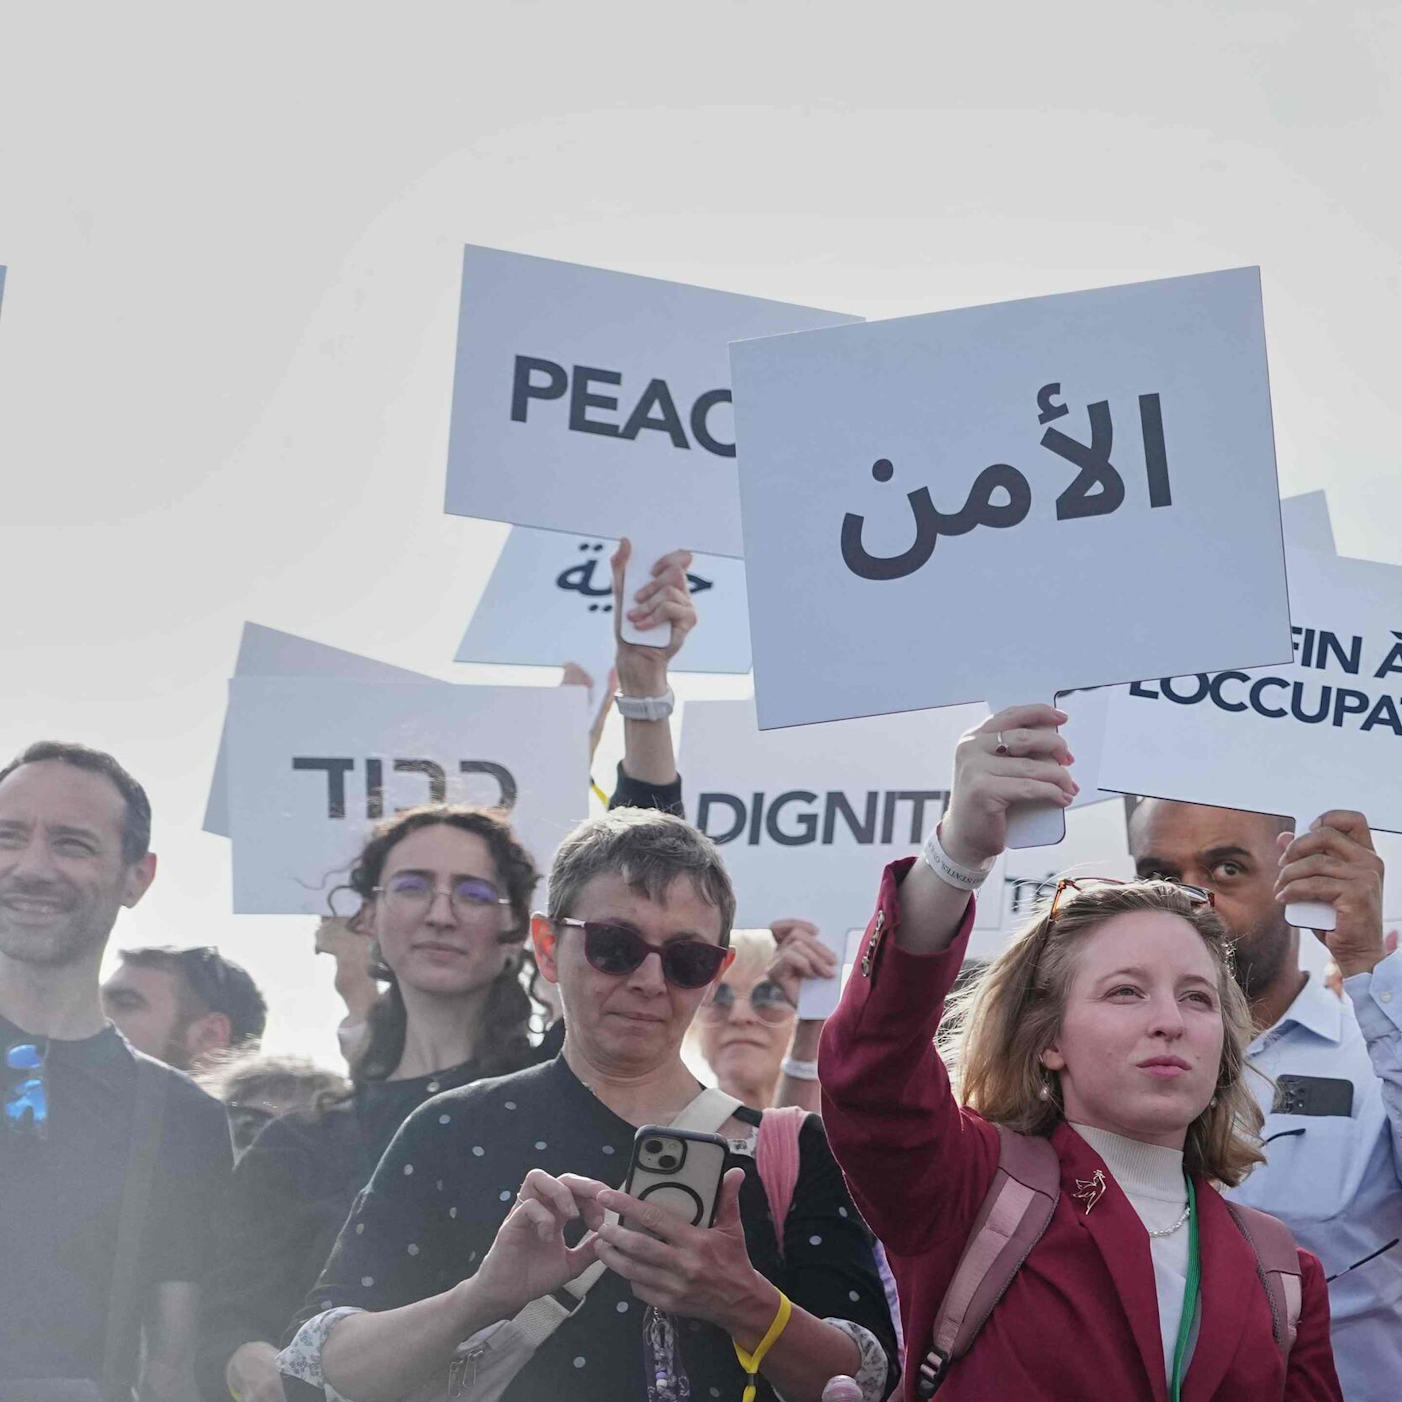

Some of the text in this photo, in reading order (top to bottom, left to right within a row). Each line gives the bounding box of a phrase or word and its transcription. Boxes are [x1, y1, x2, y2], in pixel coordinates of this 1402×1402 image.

[510, 354, 737, 458] PEAC
[840, 382, 1173, 581] الأمن
[696, 790, 951, 847] DIGNIT
